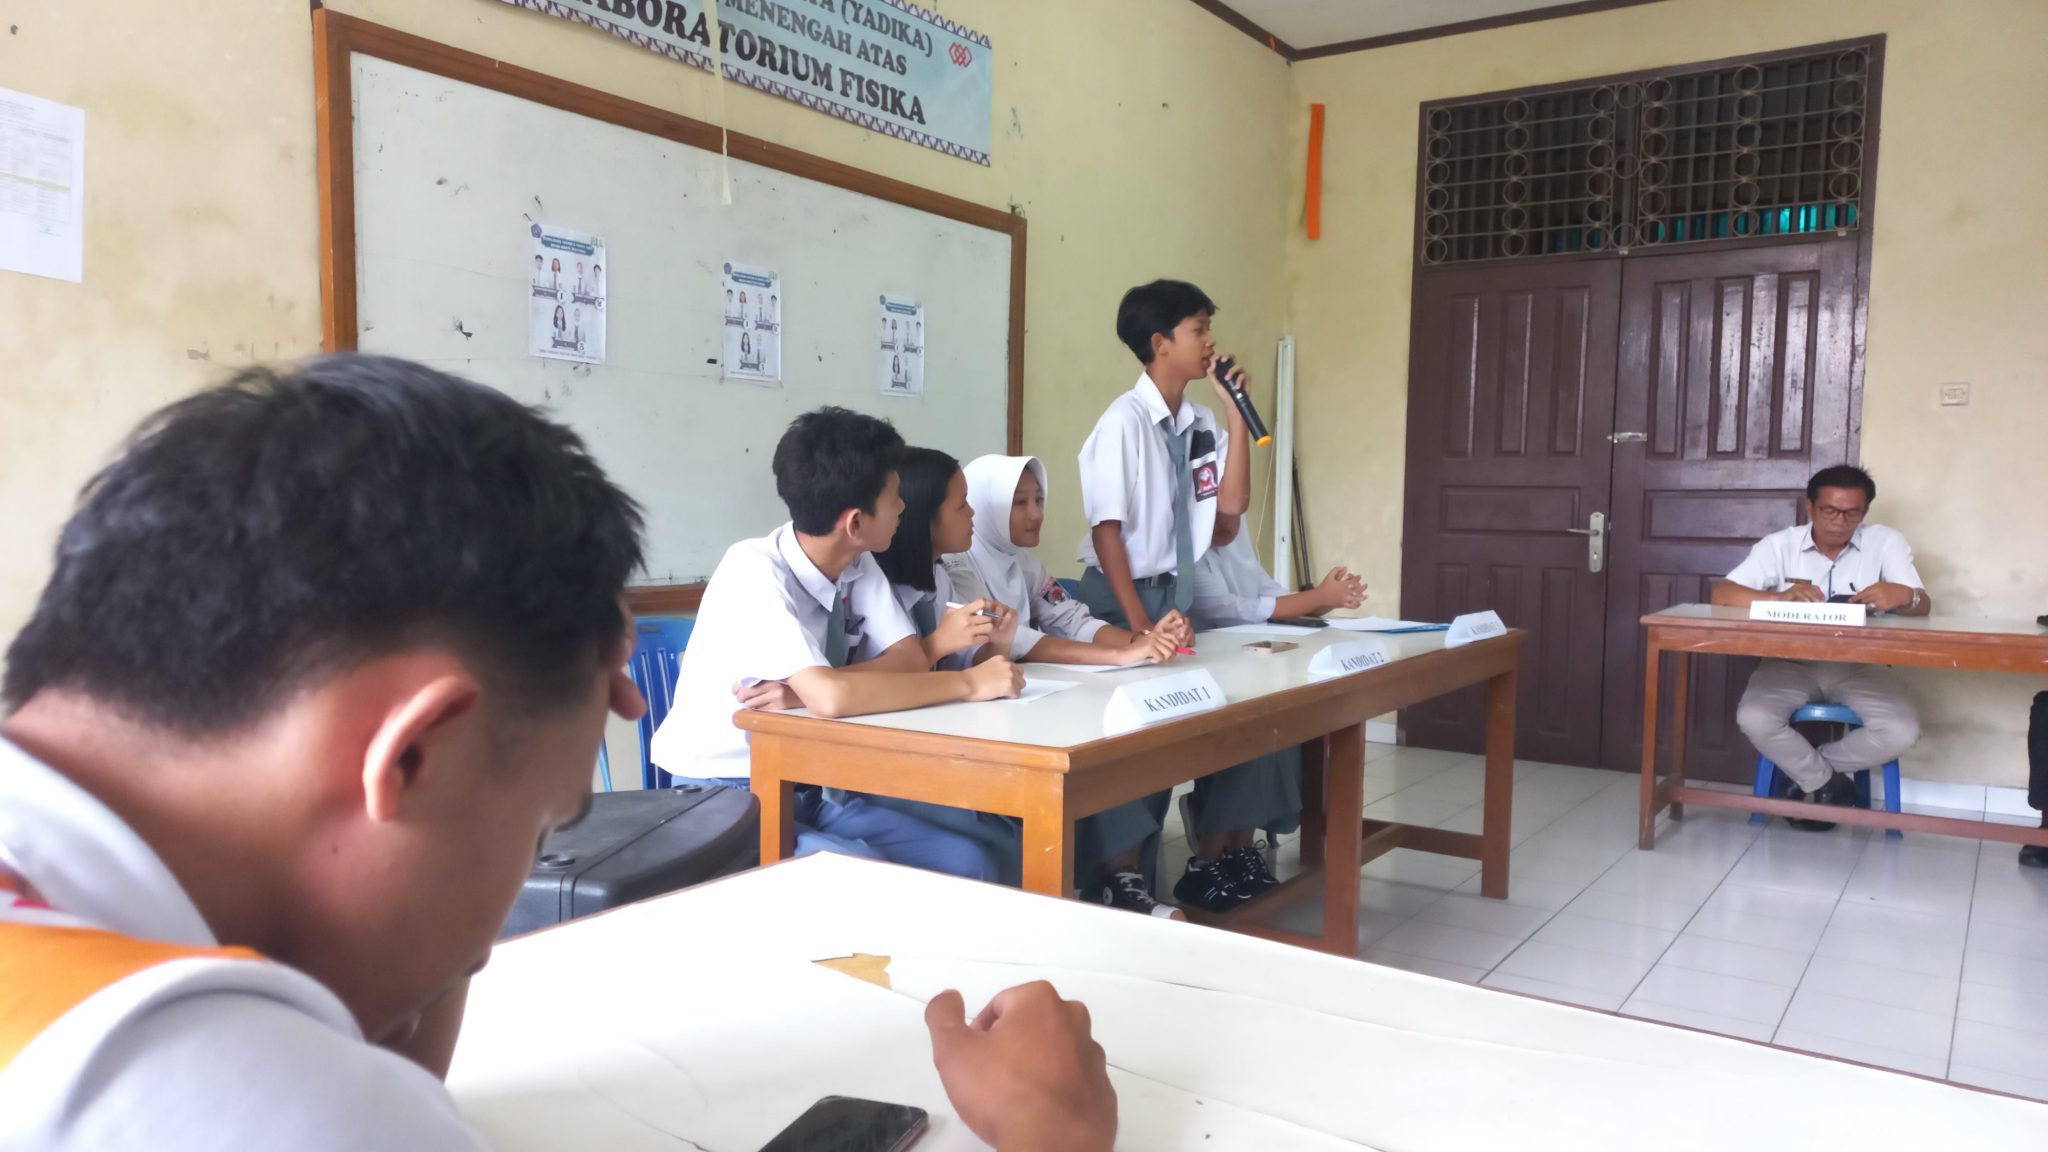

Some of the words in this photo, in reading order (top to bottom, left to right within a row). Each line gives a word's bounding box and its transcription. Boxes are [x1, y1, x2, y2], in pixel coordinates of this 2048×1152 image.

[841, 0, 933, 58] (YADIKA)
[576, 0, 834, 92] BORATORIUM
[839, 67, 926, 125] FISIKA
[856, 39, 907, 76] ATAS
[1766, 610, 1847, 622] MODERATOR
[1143, 688, 1202, 713] KANDIDAT
[1201, 686, 1211, 700] 1
